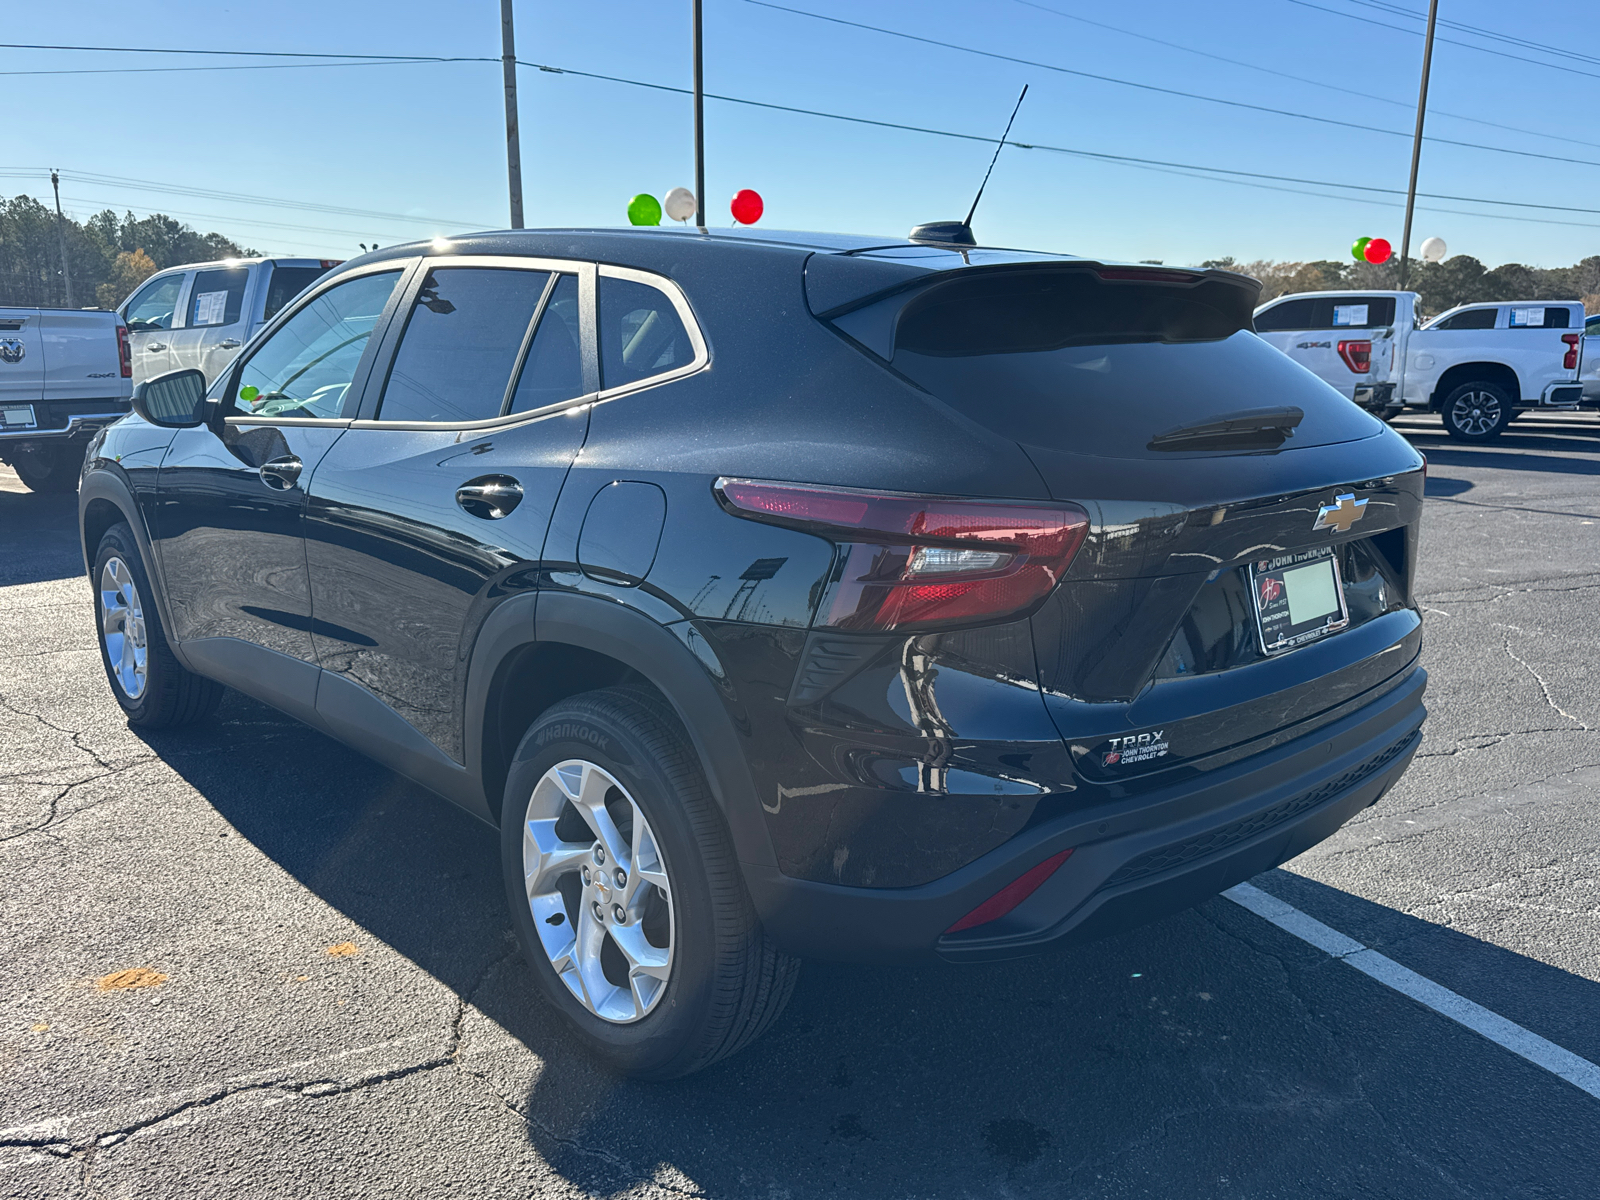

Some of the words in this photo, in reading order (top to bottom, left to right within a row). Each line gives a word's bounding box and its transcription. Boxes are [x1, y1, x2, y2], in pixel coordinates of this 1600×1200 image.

[1270, 555, 1292, 569] JOHN
[1297, 631, 1321, 643] CHEVROLET
[1109, 731, 1163, 751] TRAX
[1122, 748, 1138, 757] JOHN
[1139, 742, 1168, 753] THORNTON
[1121, 752, 1157, 764] CHEVROLET
